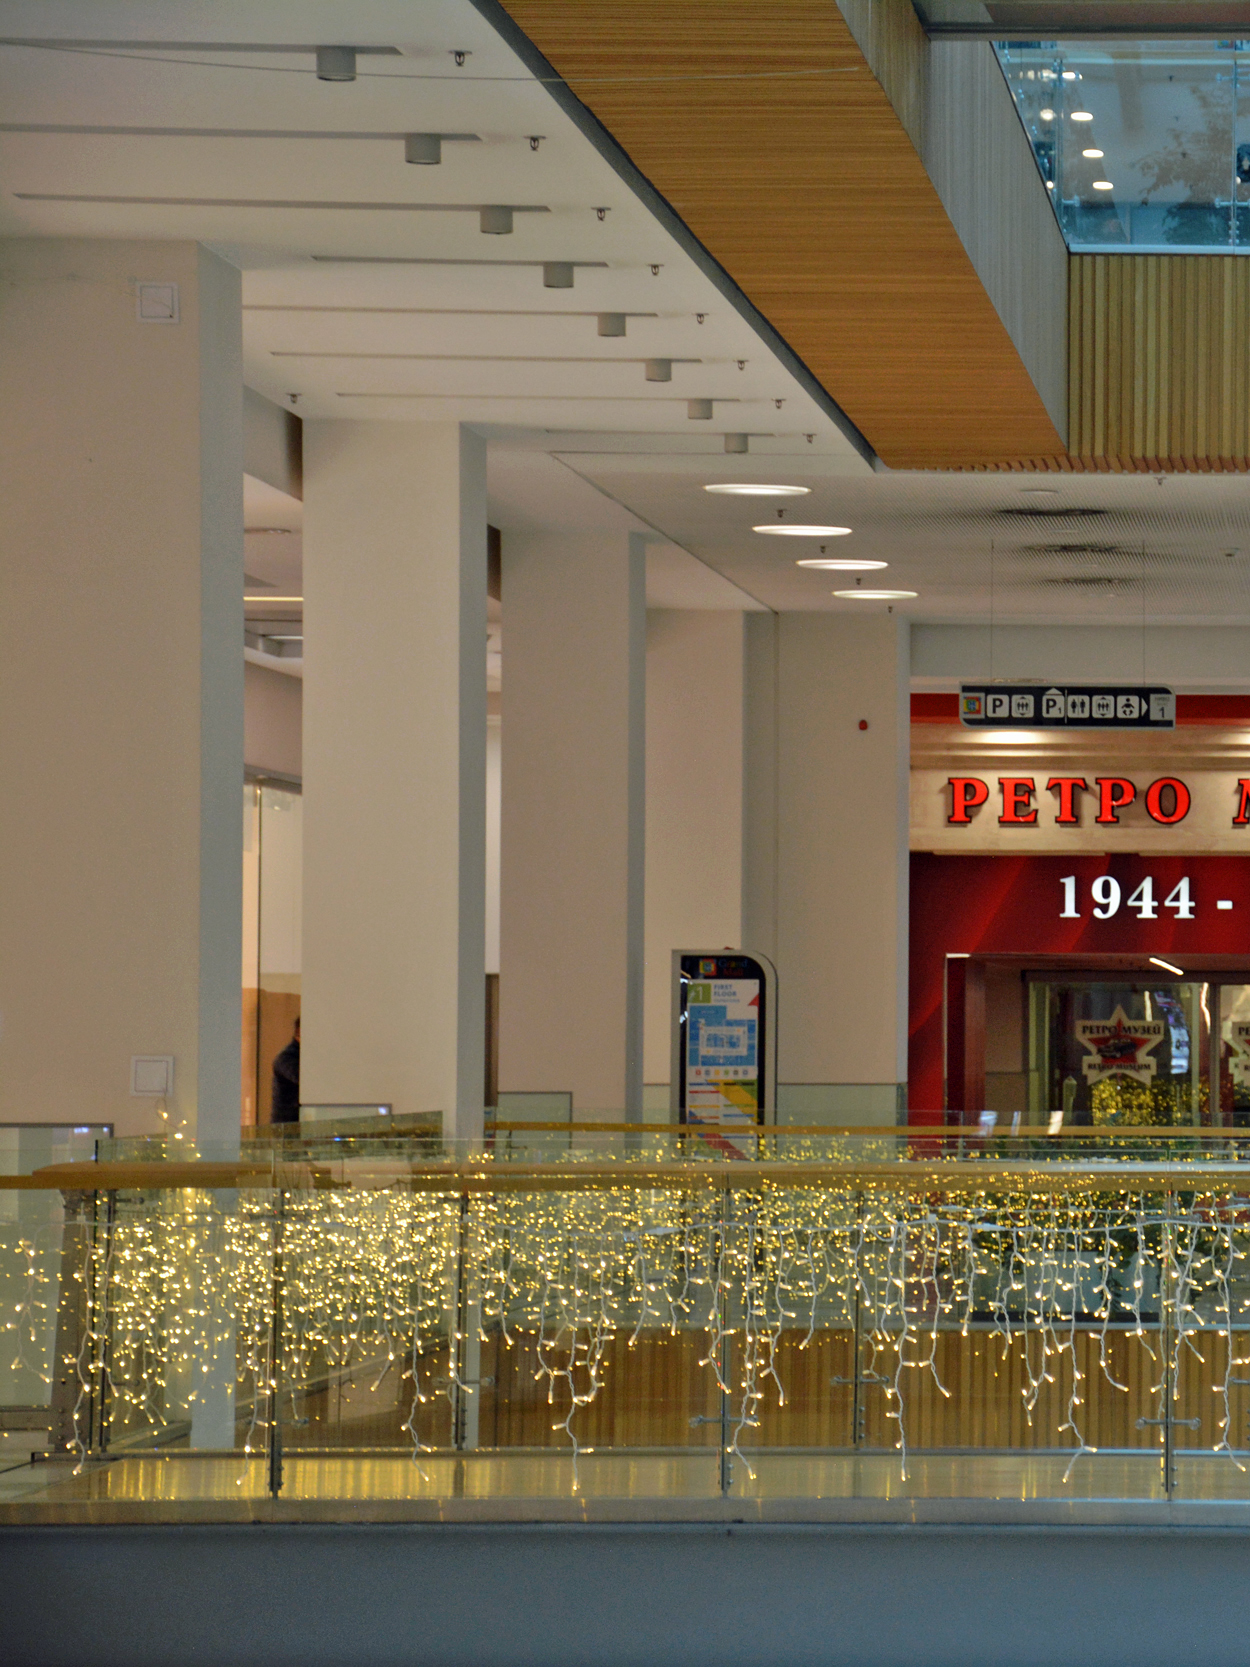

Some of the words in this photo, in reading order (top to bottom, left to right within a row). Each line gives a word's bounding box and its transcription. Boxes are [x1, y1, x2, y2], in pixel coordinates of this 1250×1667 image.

[947, 776, 1191, 825] РЕТРО
[1059, 875, 1196, 919] 1944
[1082, 1025, 1118, 1034] РЕТРО
[1121, 1024, 1161, 1035] МУЗЕЙ
